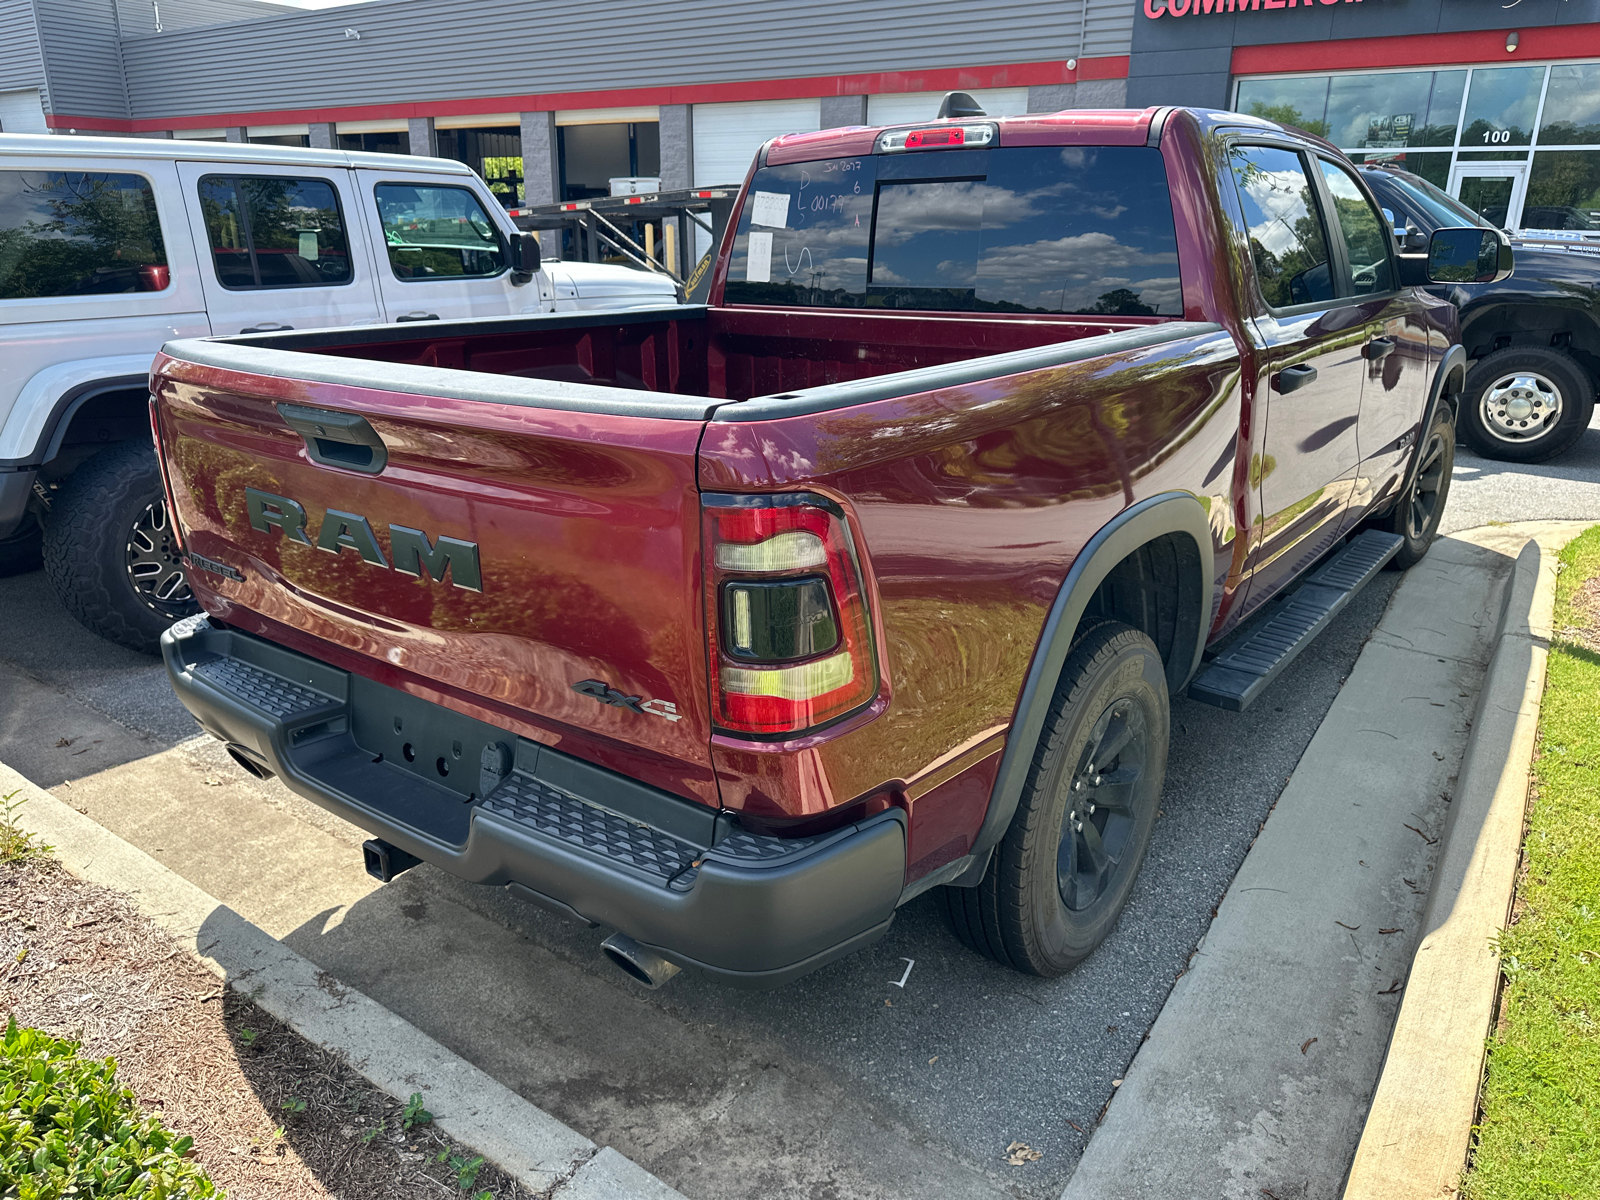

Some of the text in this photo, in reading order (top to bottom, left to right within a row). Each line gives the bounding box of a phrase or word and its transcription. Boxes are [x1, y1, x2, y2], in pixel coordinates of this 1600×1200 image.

[1482, 130, 1510, 143] 100
[245, 487, 483, 593] RAM
[190, 552, 248, 584] REBEL
